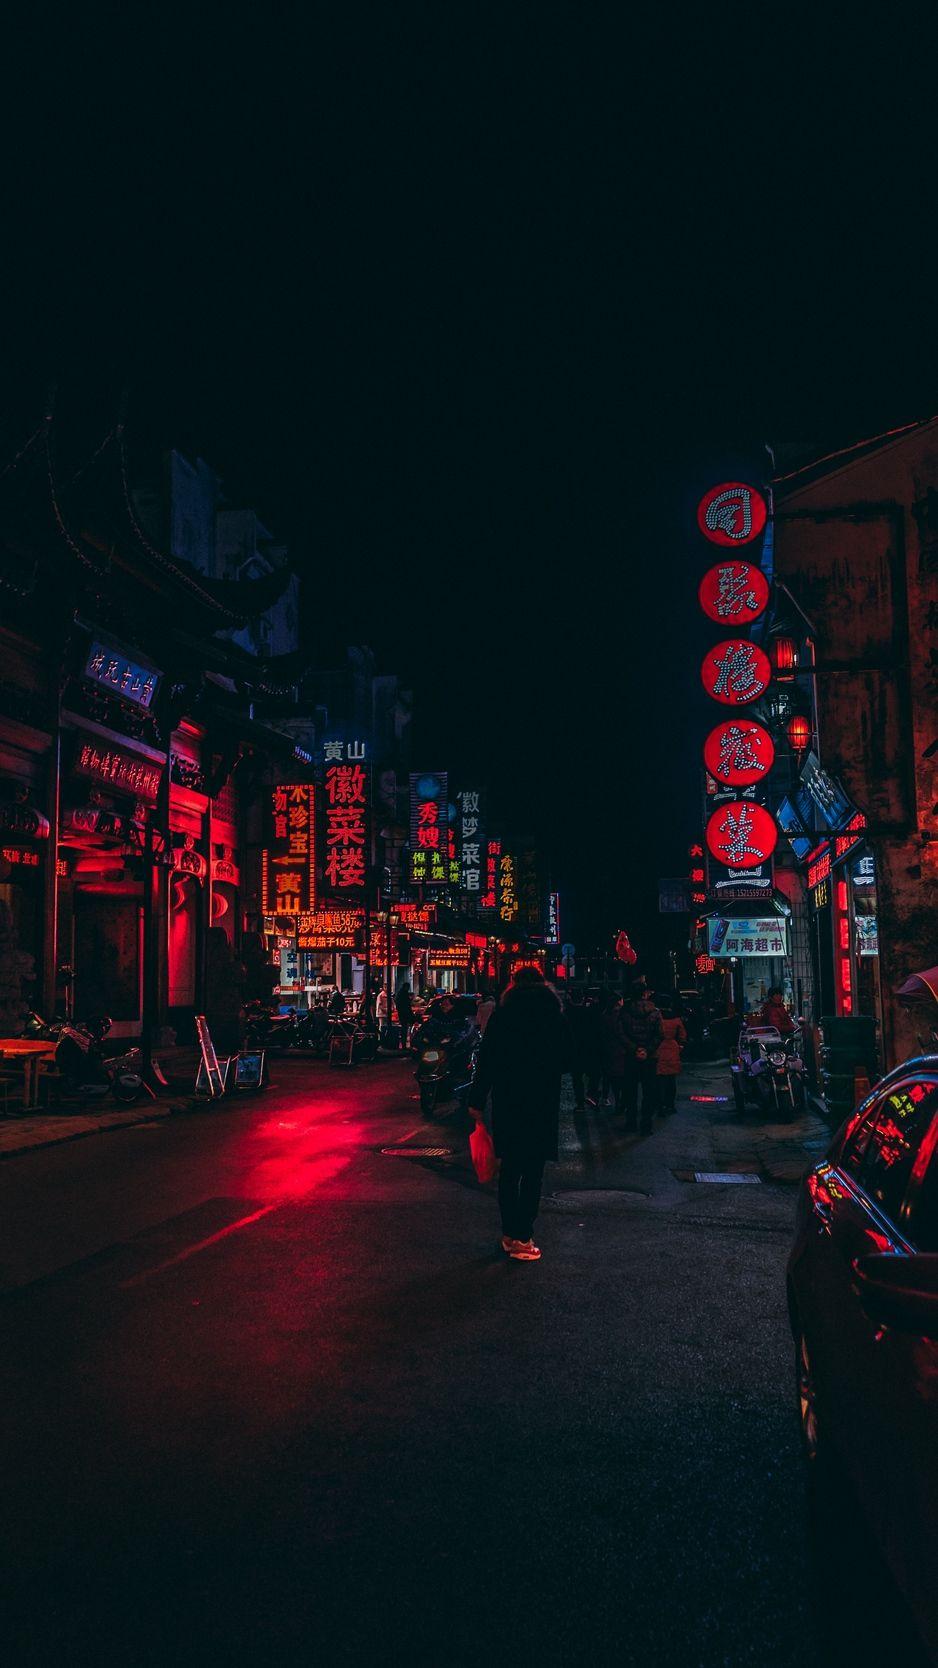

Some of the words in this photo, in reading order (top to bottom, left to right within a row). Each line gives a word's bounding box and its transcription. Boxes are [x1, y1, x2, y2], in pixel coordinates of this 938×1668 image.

[323, 740, 366, 761] 黄山
[324, 764, 367, 887] 徽菜楼
[416, 801, 440, 849] 秀嫂
[275, 872, 302, 913] 黄山
[726, 938, 783, 952] 阿海超市
